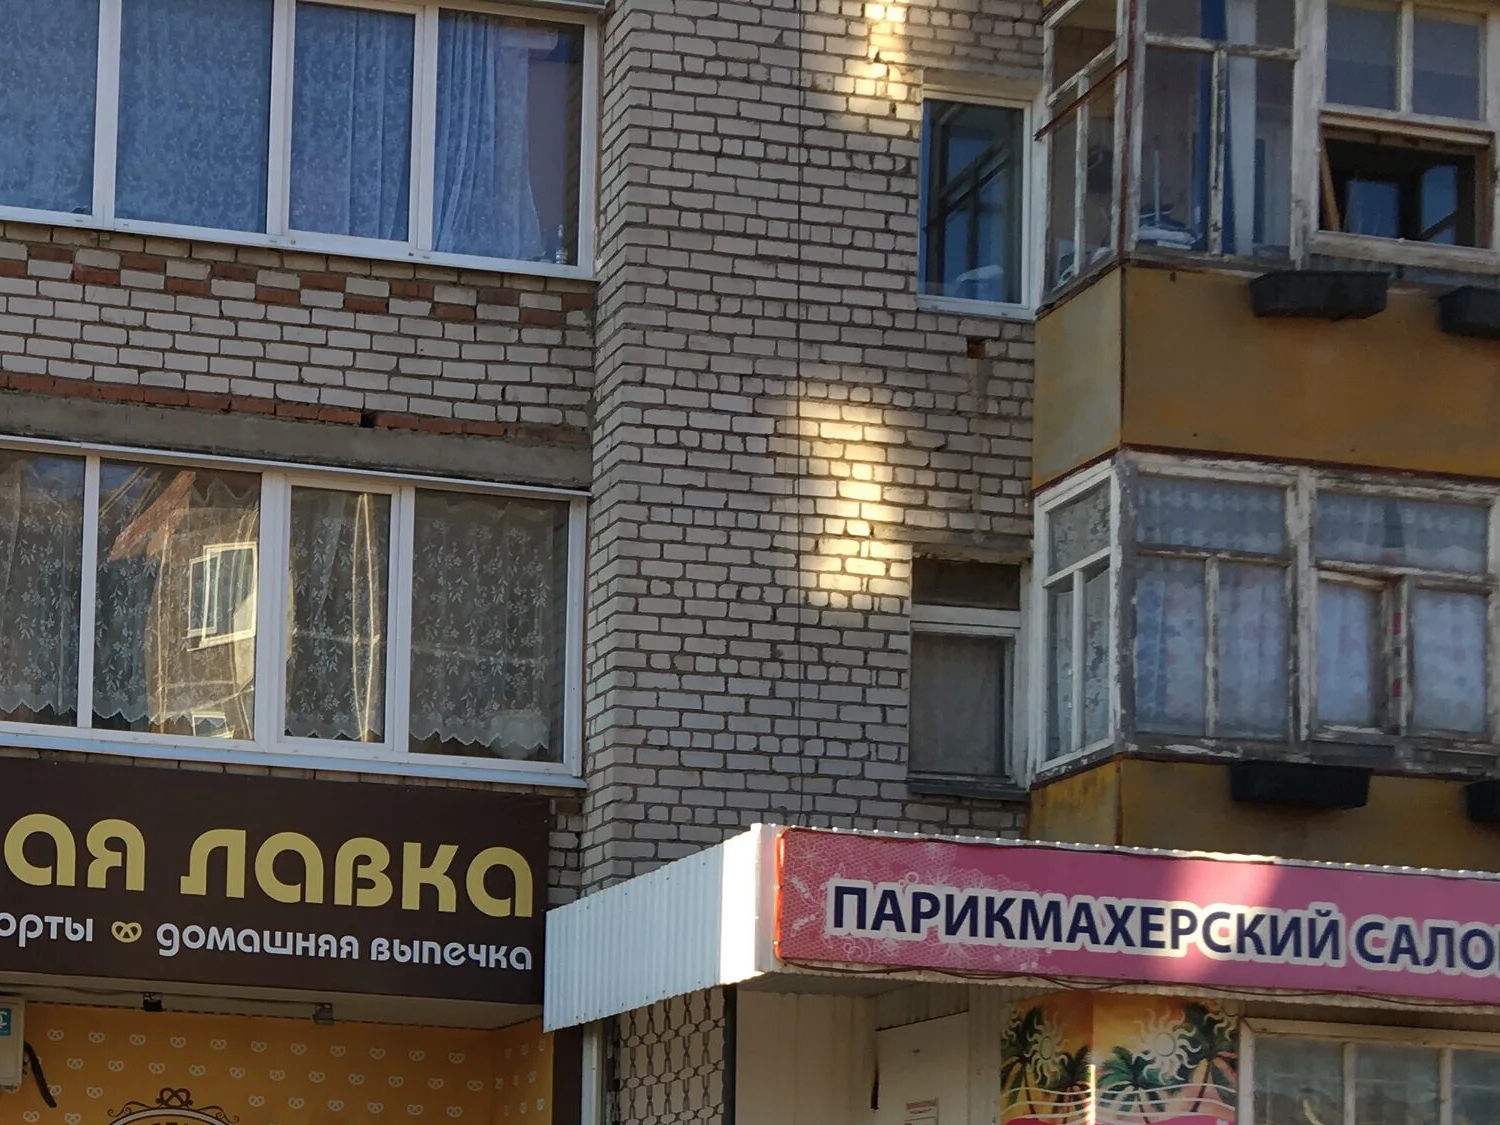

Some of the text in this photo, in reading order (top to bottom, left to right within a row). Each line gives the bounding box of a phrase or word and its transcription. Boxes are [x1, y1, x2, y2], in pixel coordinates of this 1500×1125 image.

[179, 828, 533, 918] лавка
[156, 922, 359, 960] домашняя
[370, 937, 533, 970] выпечка
[833, 885, 1500, 972] ПАРИКМАХЕРСКИЙ САЛО
